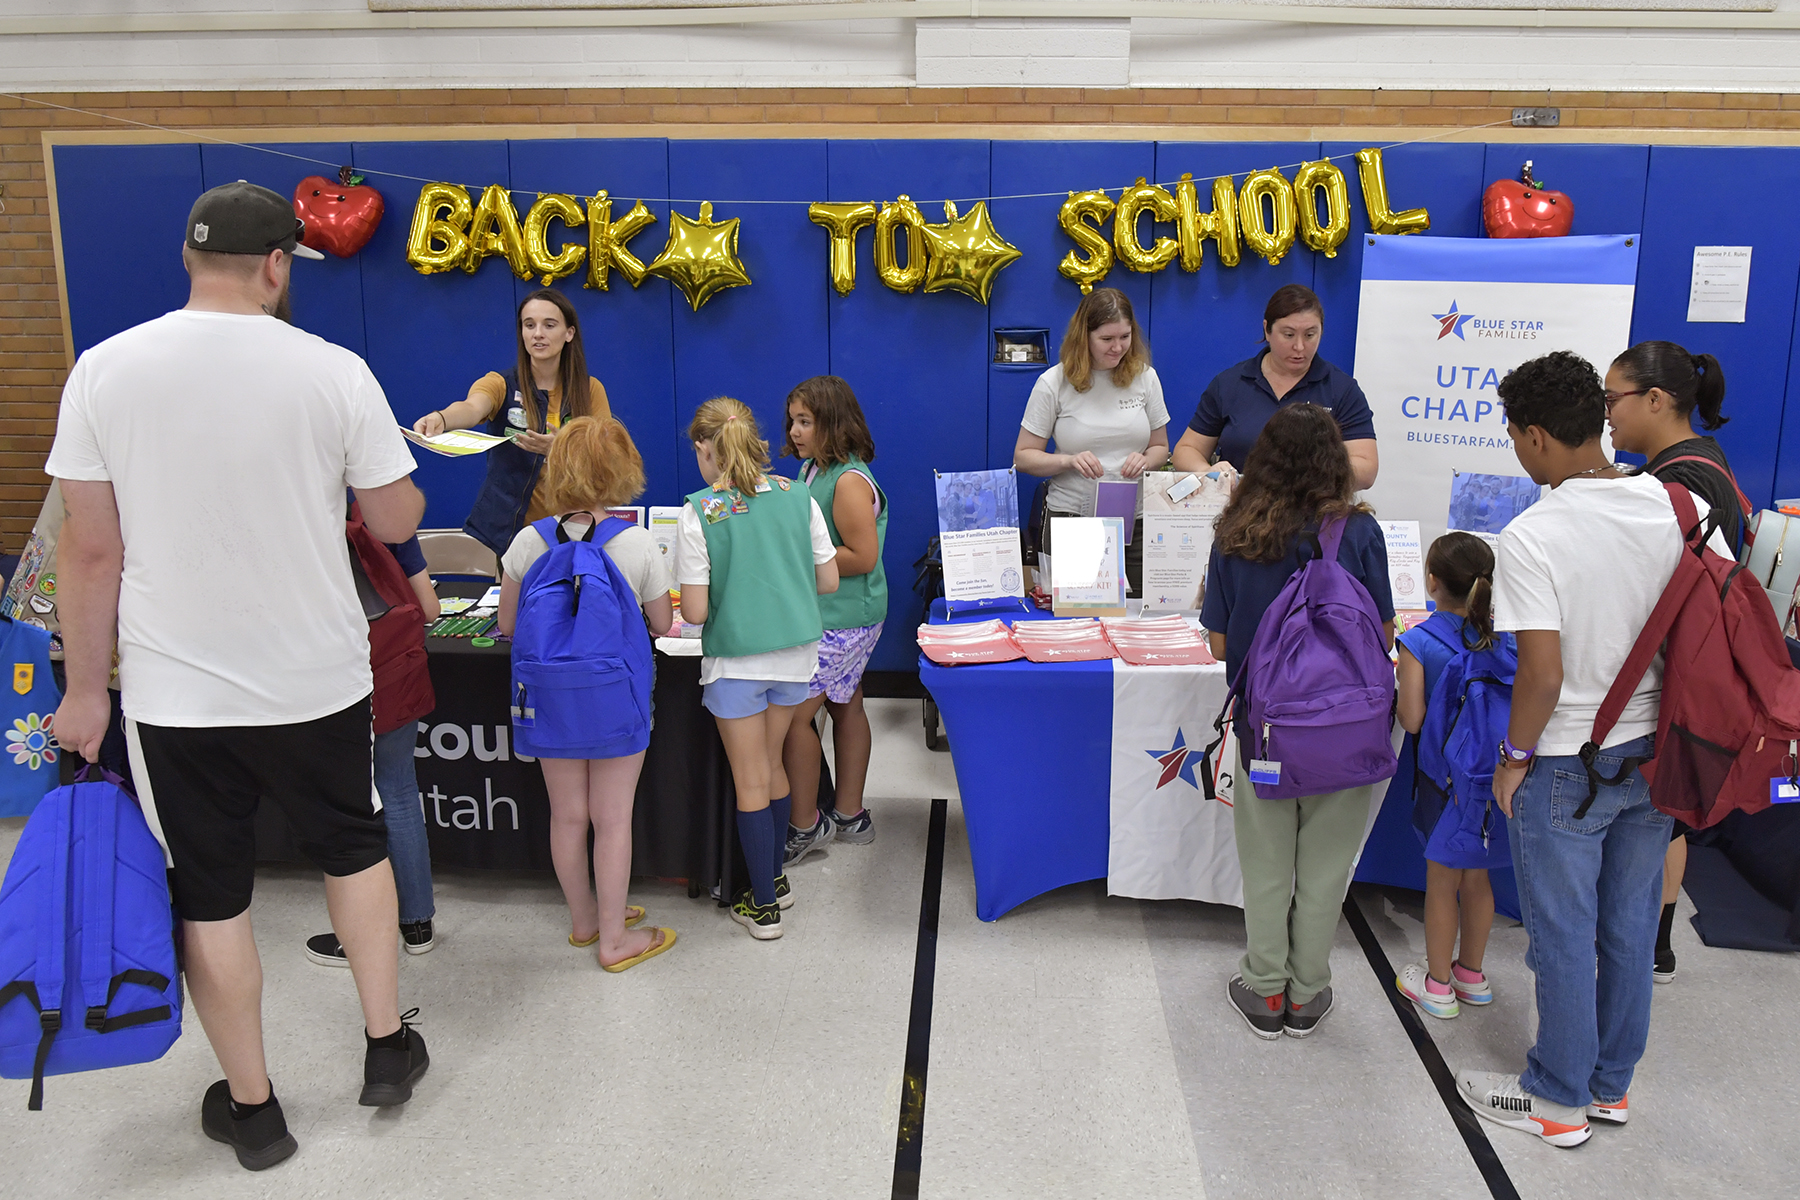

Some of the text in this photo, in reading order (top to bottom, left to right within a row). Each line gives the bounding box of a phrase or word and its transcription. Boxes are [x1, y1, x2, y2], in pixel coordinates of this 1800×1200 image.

[406, 147, 1431, 297] BACK TO SCHOOL
[1473, 319, 1544, 331] BLUE STAR
[1478, 329, 1537, 340] FAMILIES
[1436, 365, 1513, 390] UTA
[1401, 396, 1508, 425] CHAPT
[1491, 1094, 1532, 1113] PUMA
